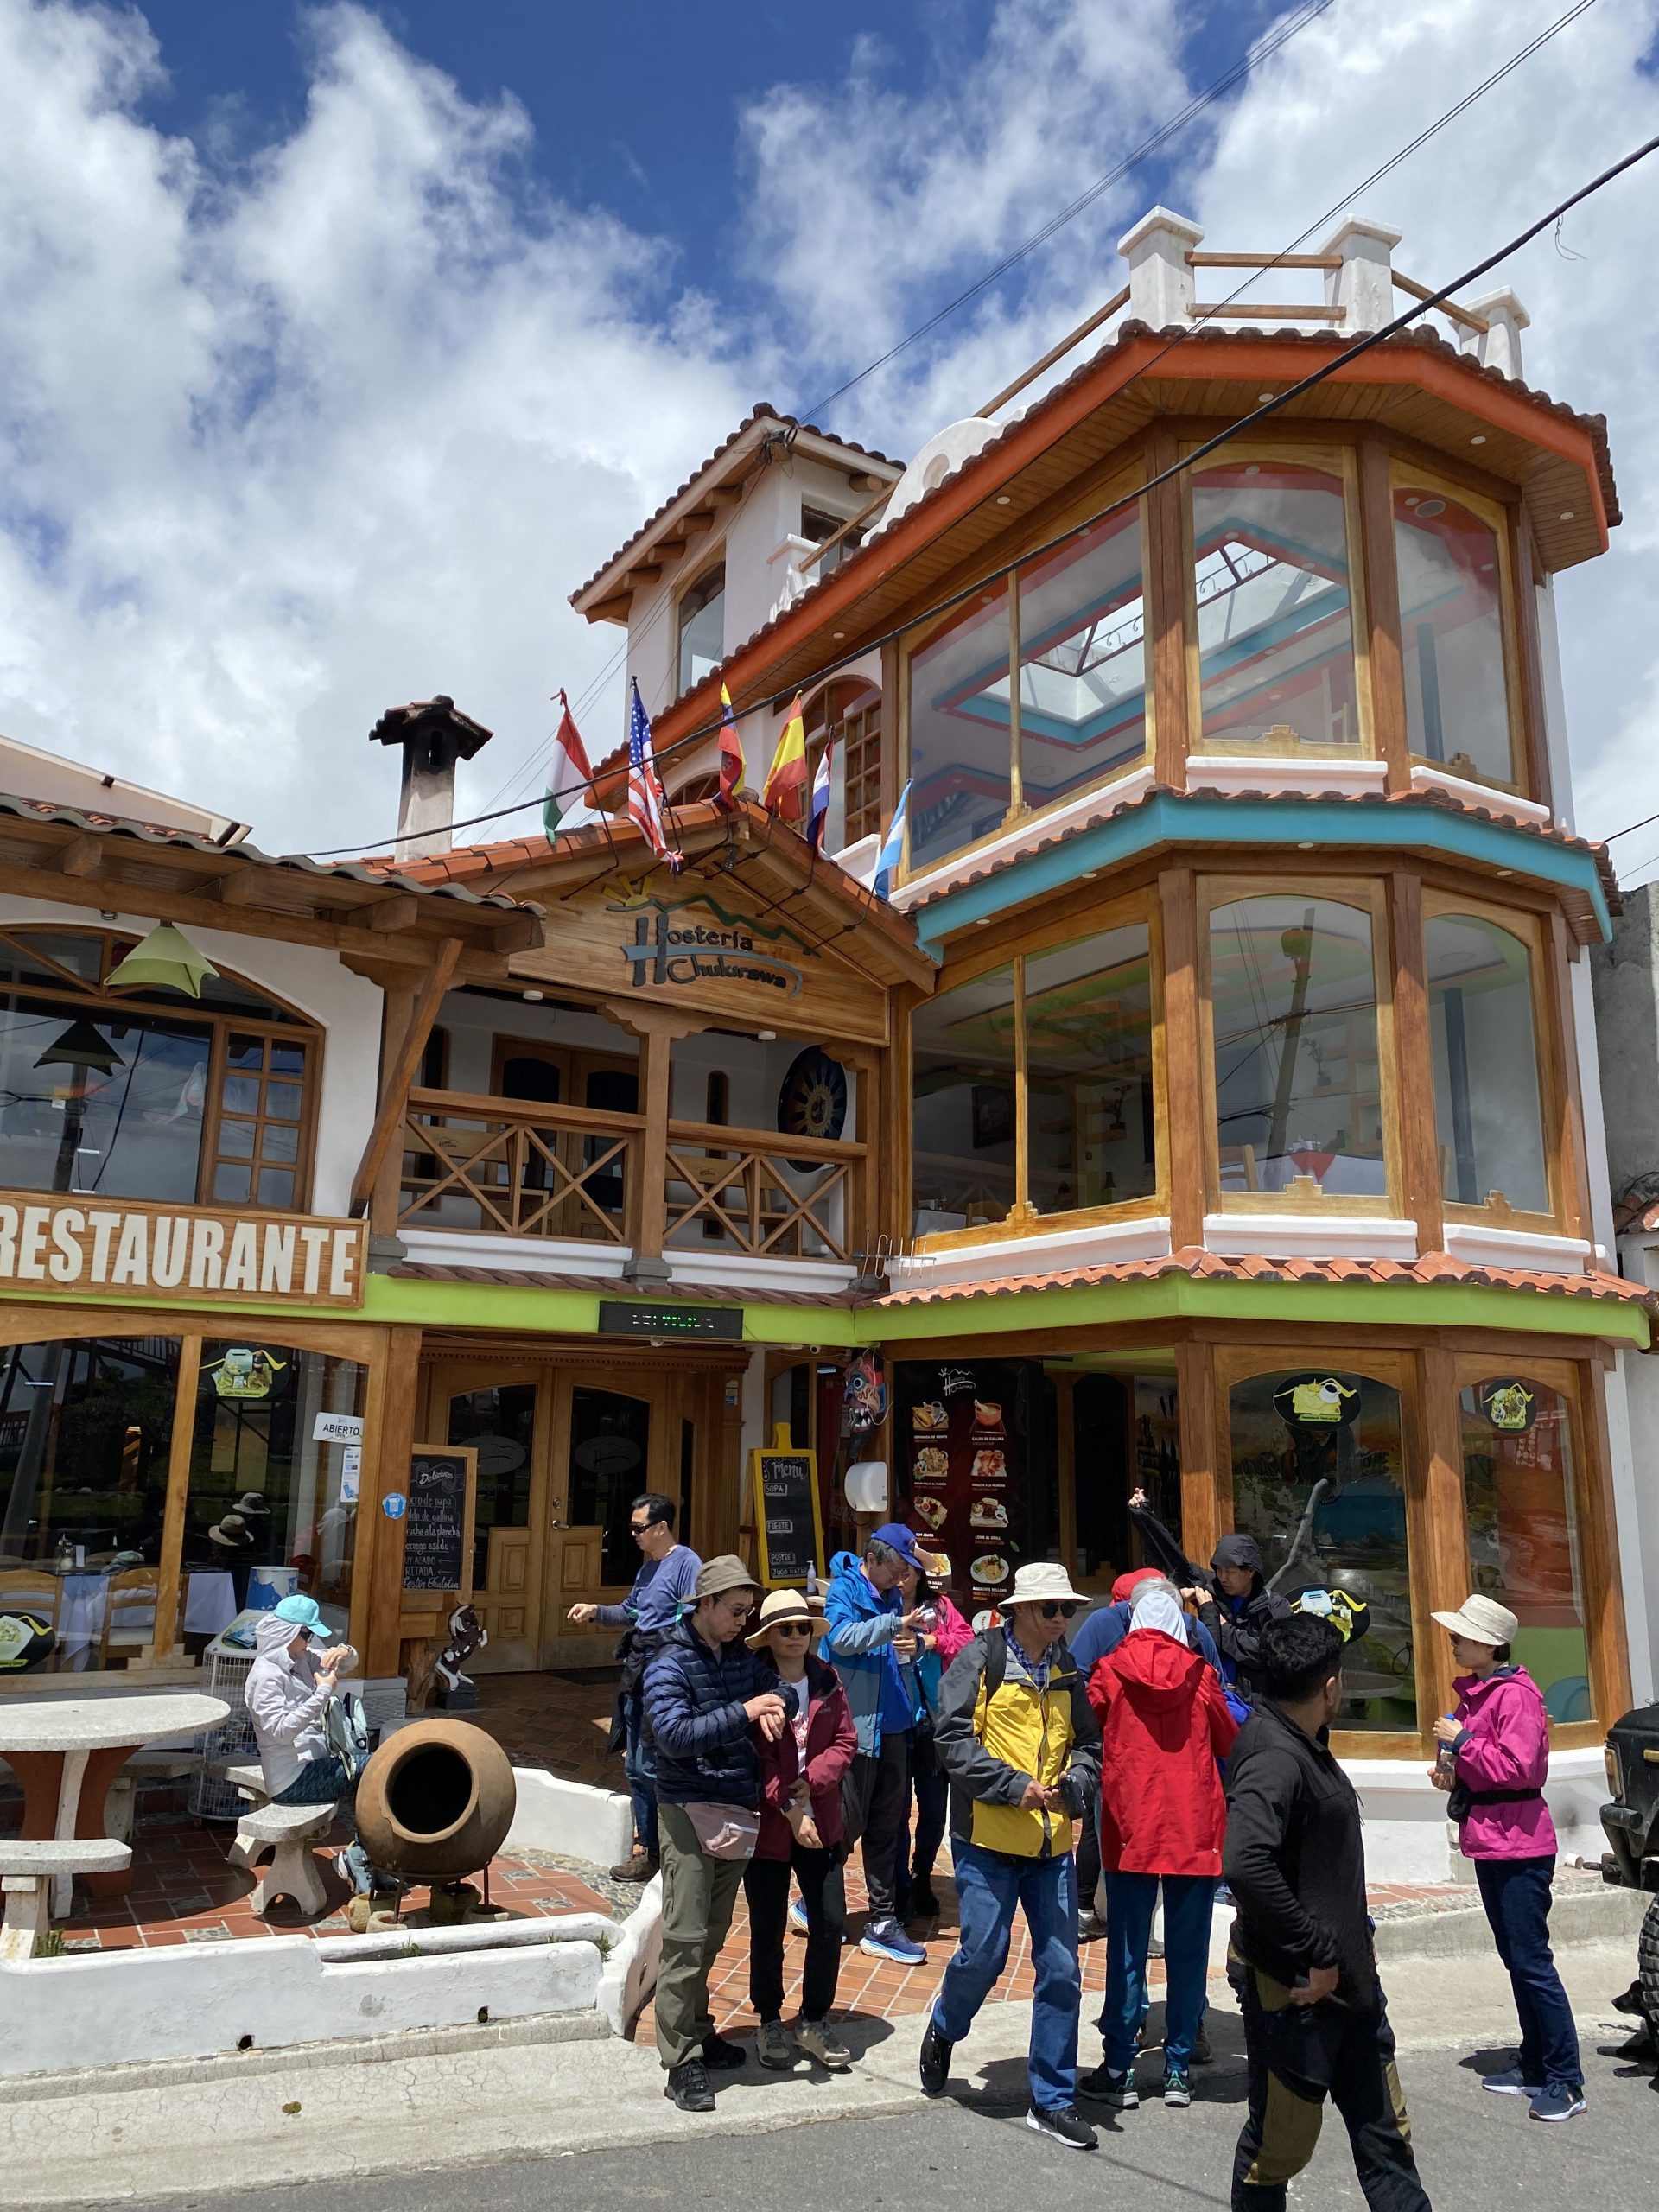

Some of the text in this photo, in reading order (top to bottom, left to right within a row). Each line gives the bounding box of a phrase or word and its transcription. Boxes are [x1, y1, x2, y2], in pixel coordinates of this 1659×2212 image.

[0, 1204, 357, 1296] RESTAURANTE
[322, 1423, 359, 1436] ABIERTO
[405, 1566, 434, 1577] RITADA
